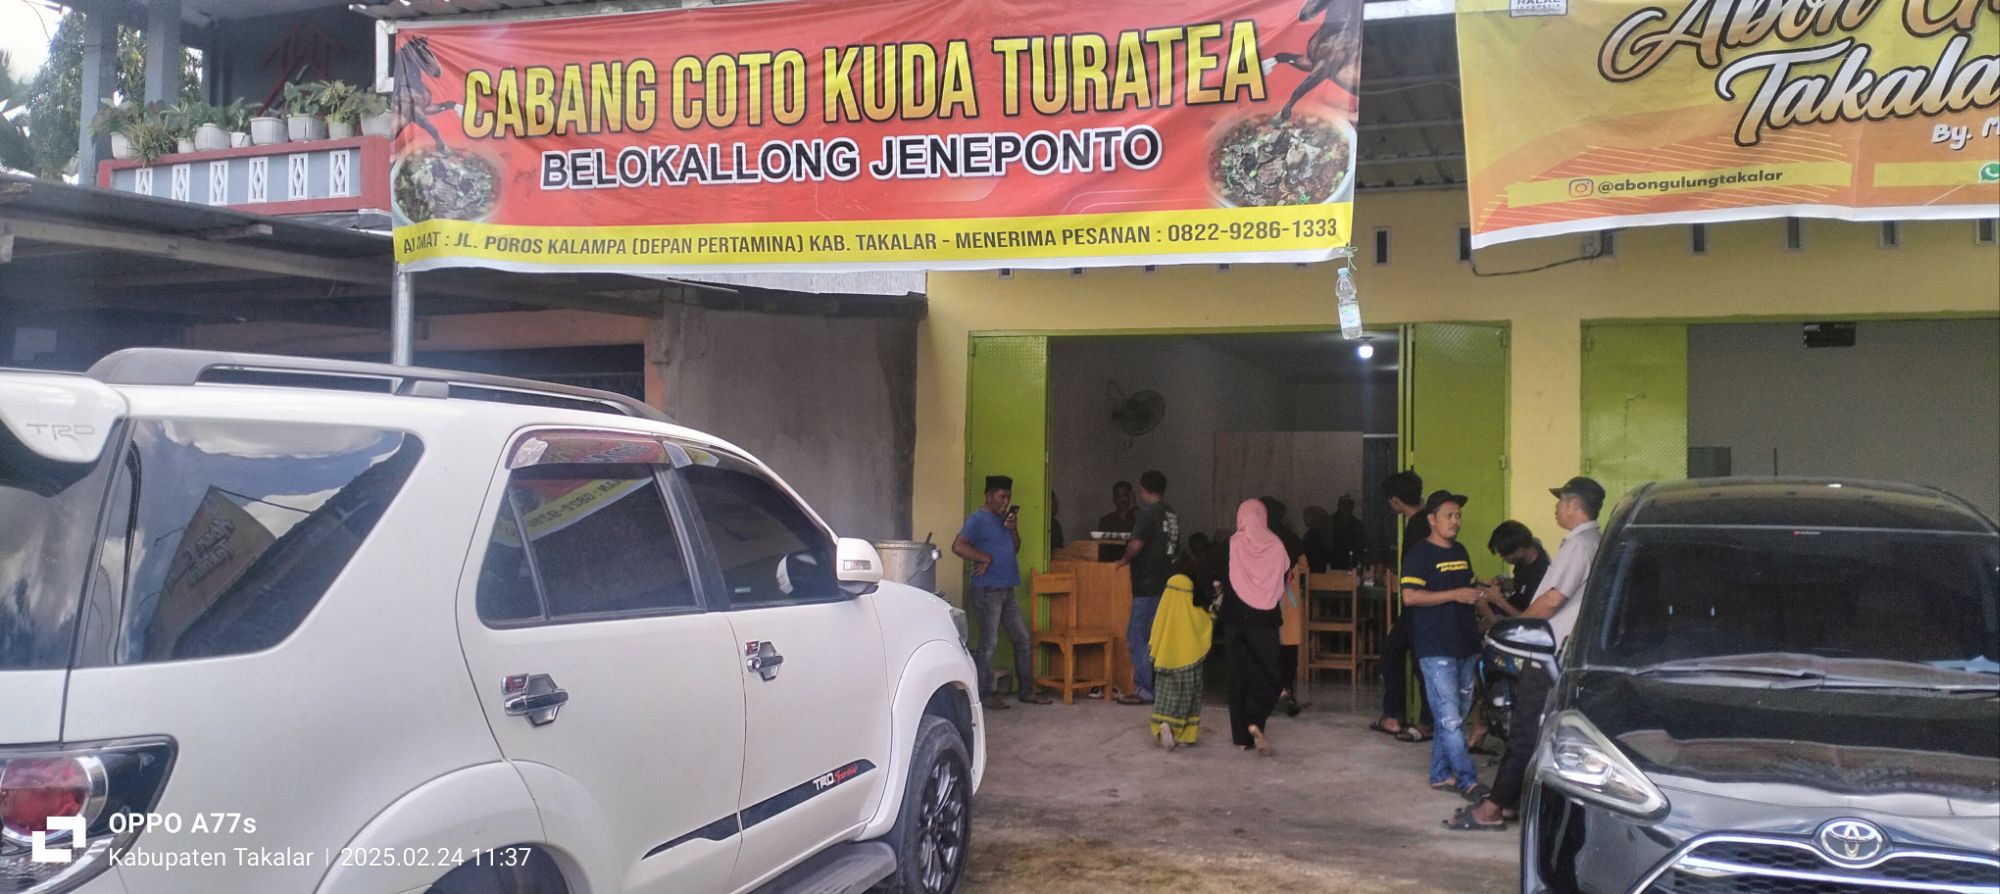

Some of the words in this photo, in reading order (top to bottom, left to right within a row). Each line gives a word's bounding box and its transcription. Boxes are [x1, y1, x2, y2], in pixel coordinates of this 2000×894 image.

[463, 59, 657, 139] CABANG
[671, 49, 806, 129] COTO
[822, 40, 982, 123] KUDA
[993, 20, 1267, 117] TURATEA
[1932, 123, 1973, 150] By.
[540, 137, 858, 190] BELOKALLONG
[870, 124, 1162, 180] JENEPONTO
[1598, 171, 1783, 193] @abongulungtakalar
[453, 232, 478, 249] JL.
[484, 236, 543, 254] POROS
[547, 239, 627, 255] KALAMPA
[809, 235, 851, 251] KAB.
[856, 233, 937, 251] TAKALAR
[956, 230, 1057, 249] MENERIMA
[1062, 226, 1150, 245] PESANAN
[1168, 218, 1337, 241] 0822-9286-1333
[26, 423, 96, 441] TRD
[813, 772, 835, 791] TRD
